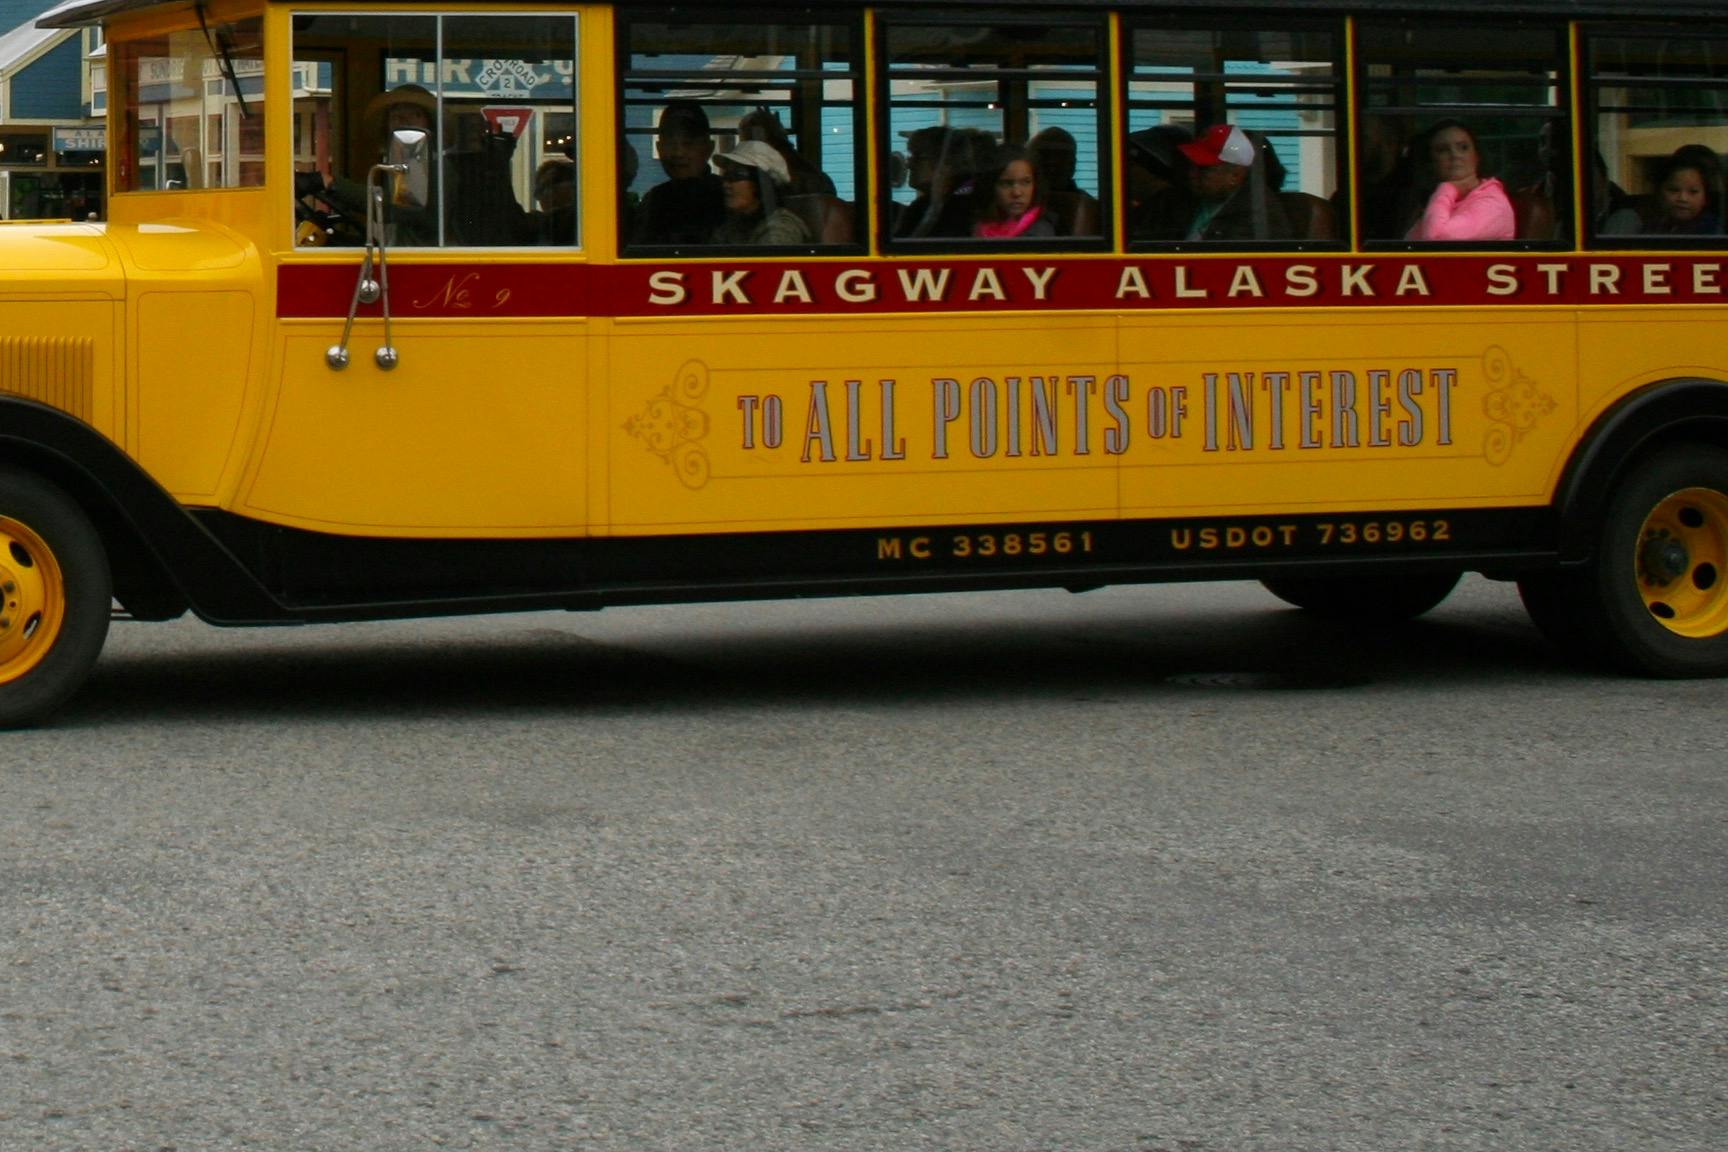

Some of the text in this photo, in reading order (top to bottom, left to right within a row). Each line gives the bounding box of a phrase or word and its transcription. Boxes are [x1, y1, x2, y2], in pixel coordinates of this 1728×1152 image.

[503, 78, 511, 89] 2
[491, 288, 511, 308] 9
[647, 262, 1721, 305] SKAGWAY ALASKA STREE
[737, 368, 1458, 463] TO ALL POINTS OF INTEREST
[877, 530, 1092, 560] MC 338561
[1171, 520, 1451, 550] USDOT 736962
